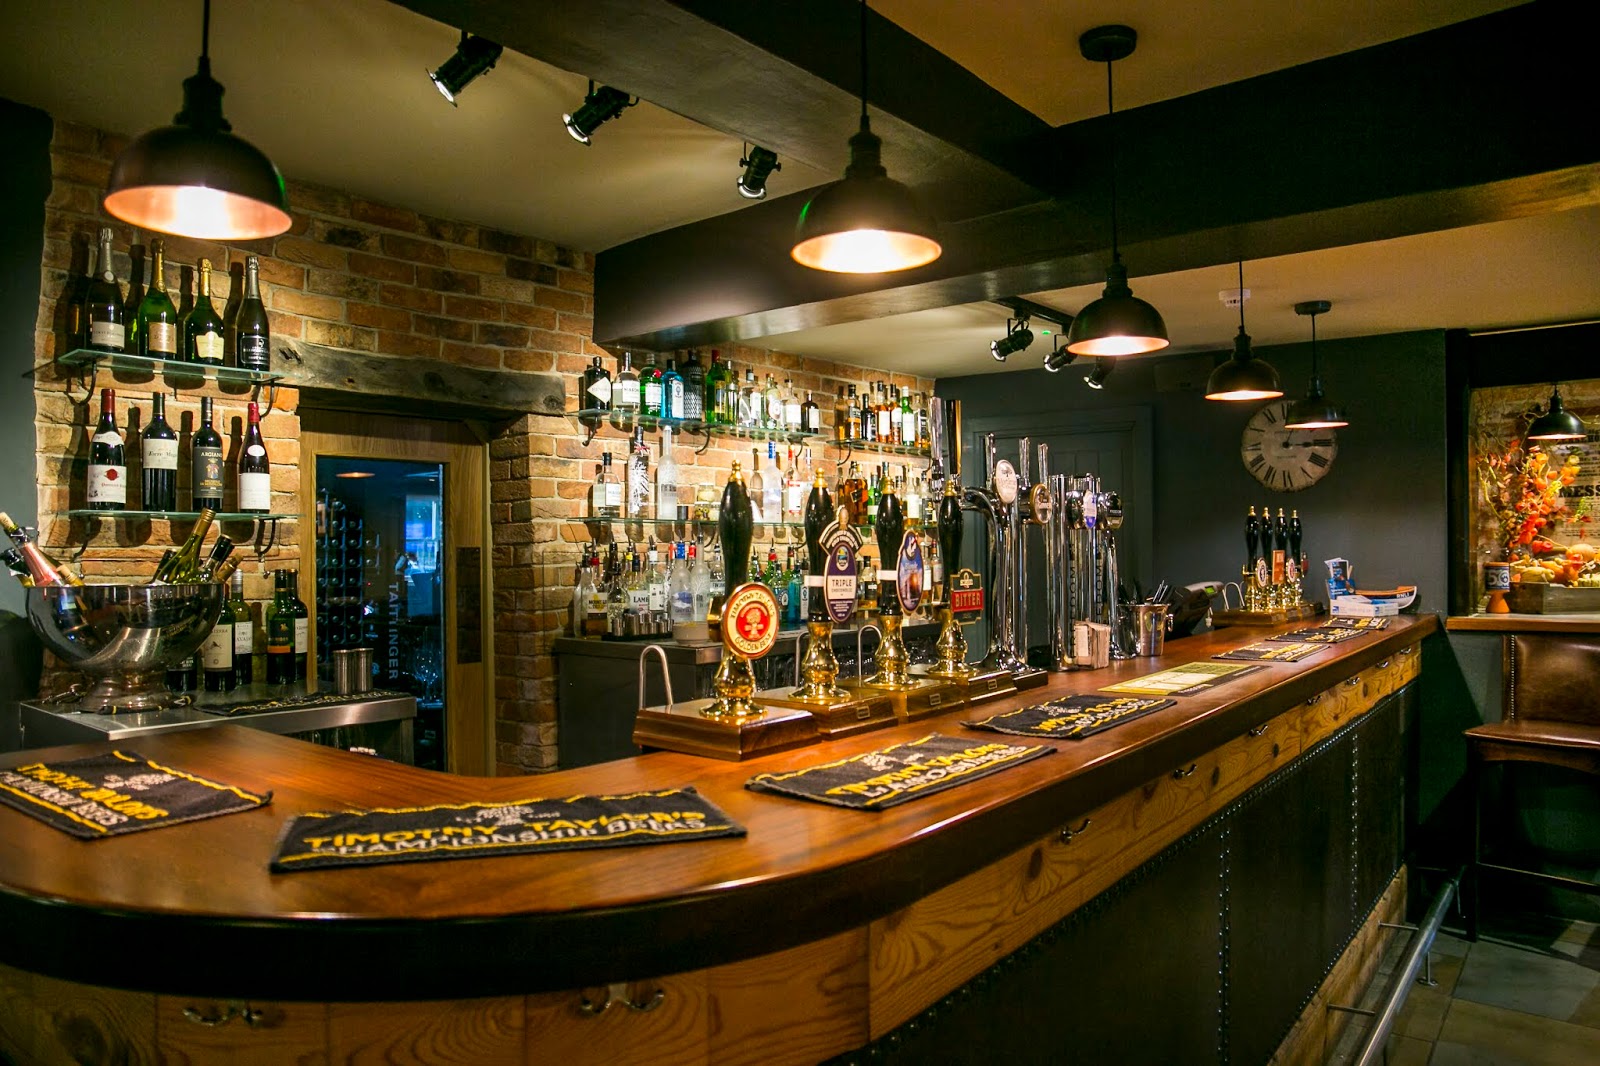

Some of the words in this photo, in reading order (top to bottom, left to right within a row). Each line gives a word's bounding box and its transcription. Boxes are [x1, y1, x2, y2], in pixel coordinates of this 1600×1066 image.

[831, 579, 852, 587] TRIPLE
[955, 592, 981, 608] BITTER
[388, 582, 400, 680] TAITTINGER
[303, 826, 500, 848] TIMOTHY
